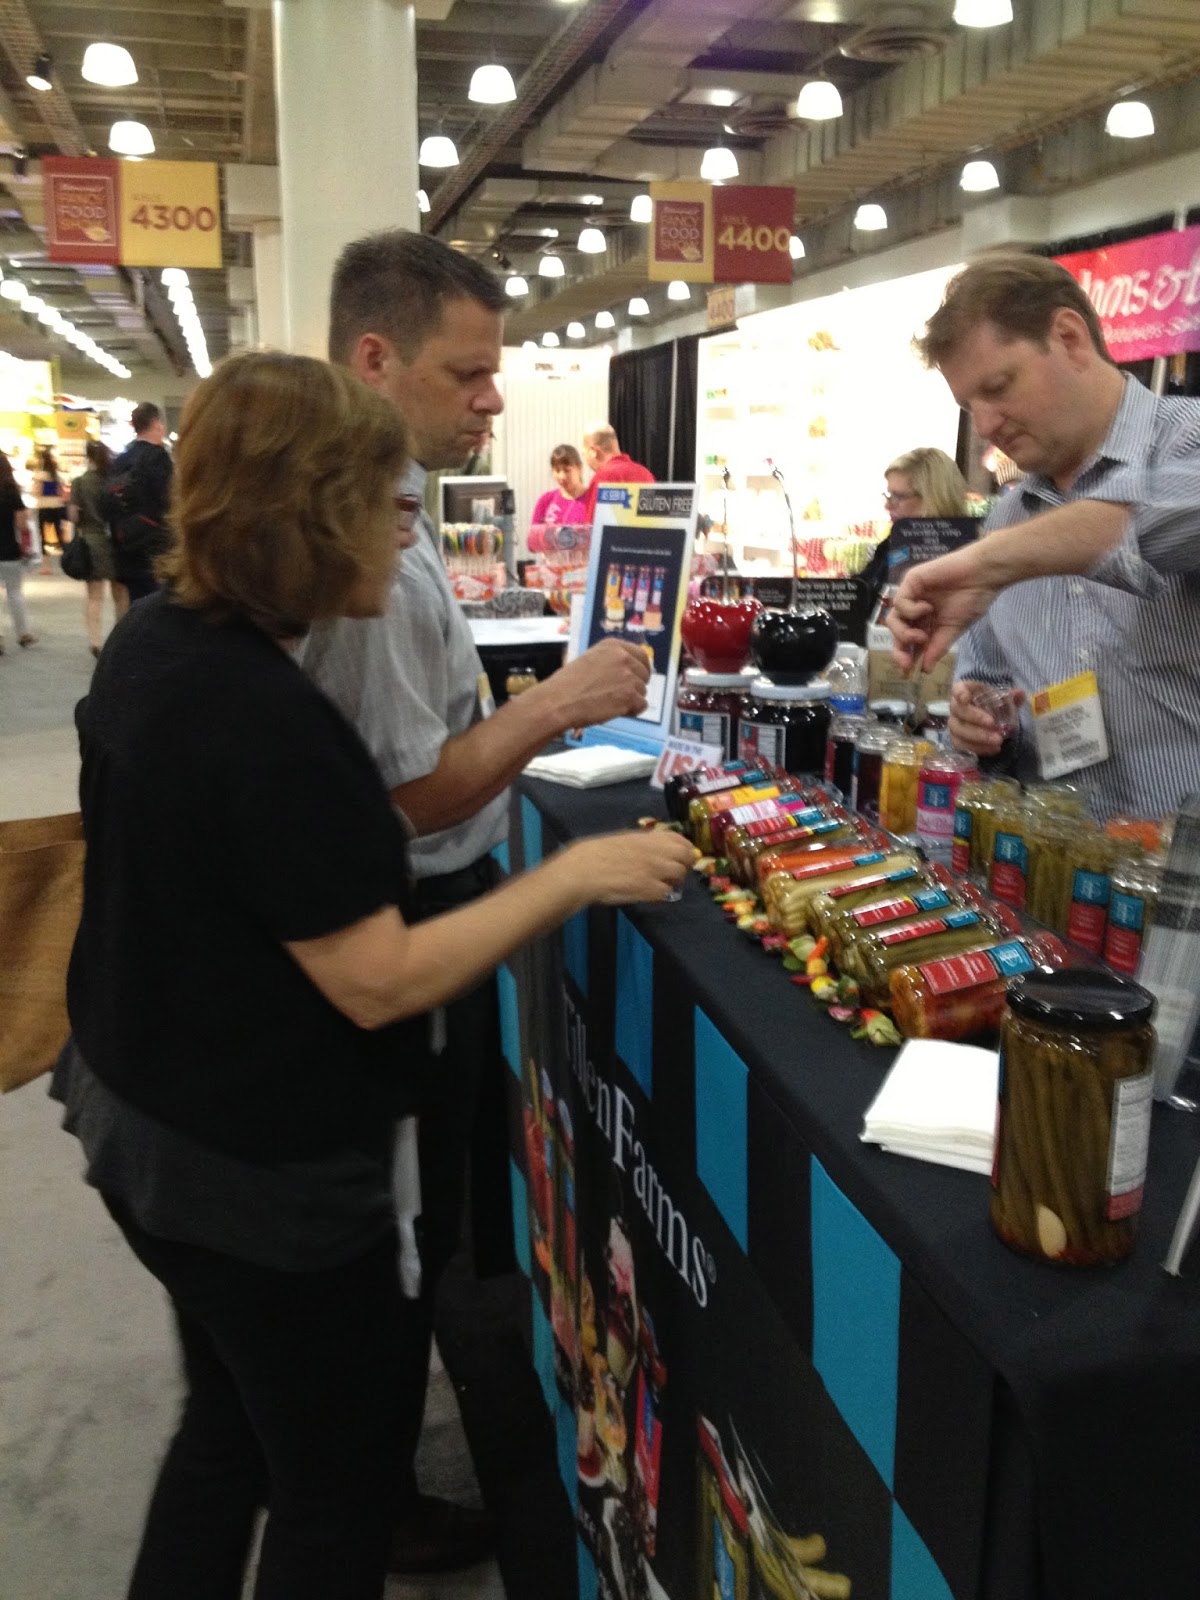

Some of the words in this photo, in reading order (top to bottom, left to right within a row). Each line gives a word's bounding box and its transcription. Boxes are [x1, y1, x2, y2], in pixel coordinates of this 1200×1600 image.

[60, 205, 107, 219] FOOD
[130, 204, 217, 232] 4300
[660, 227, 699, 240] FOOD
[718, 224, 791, 252] 4400
[639, 497, 672, 511] GLUTEN
[672, 498, 692, 512] FREE
